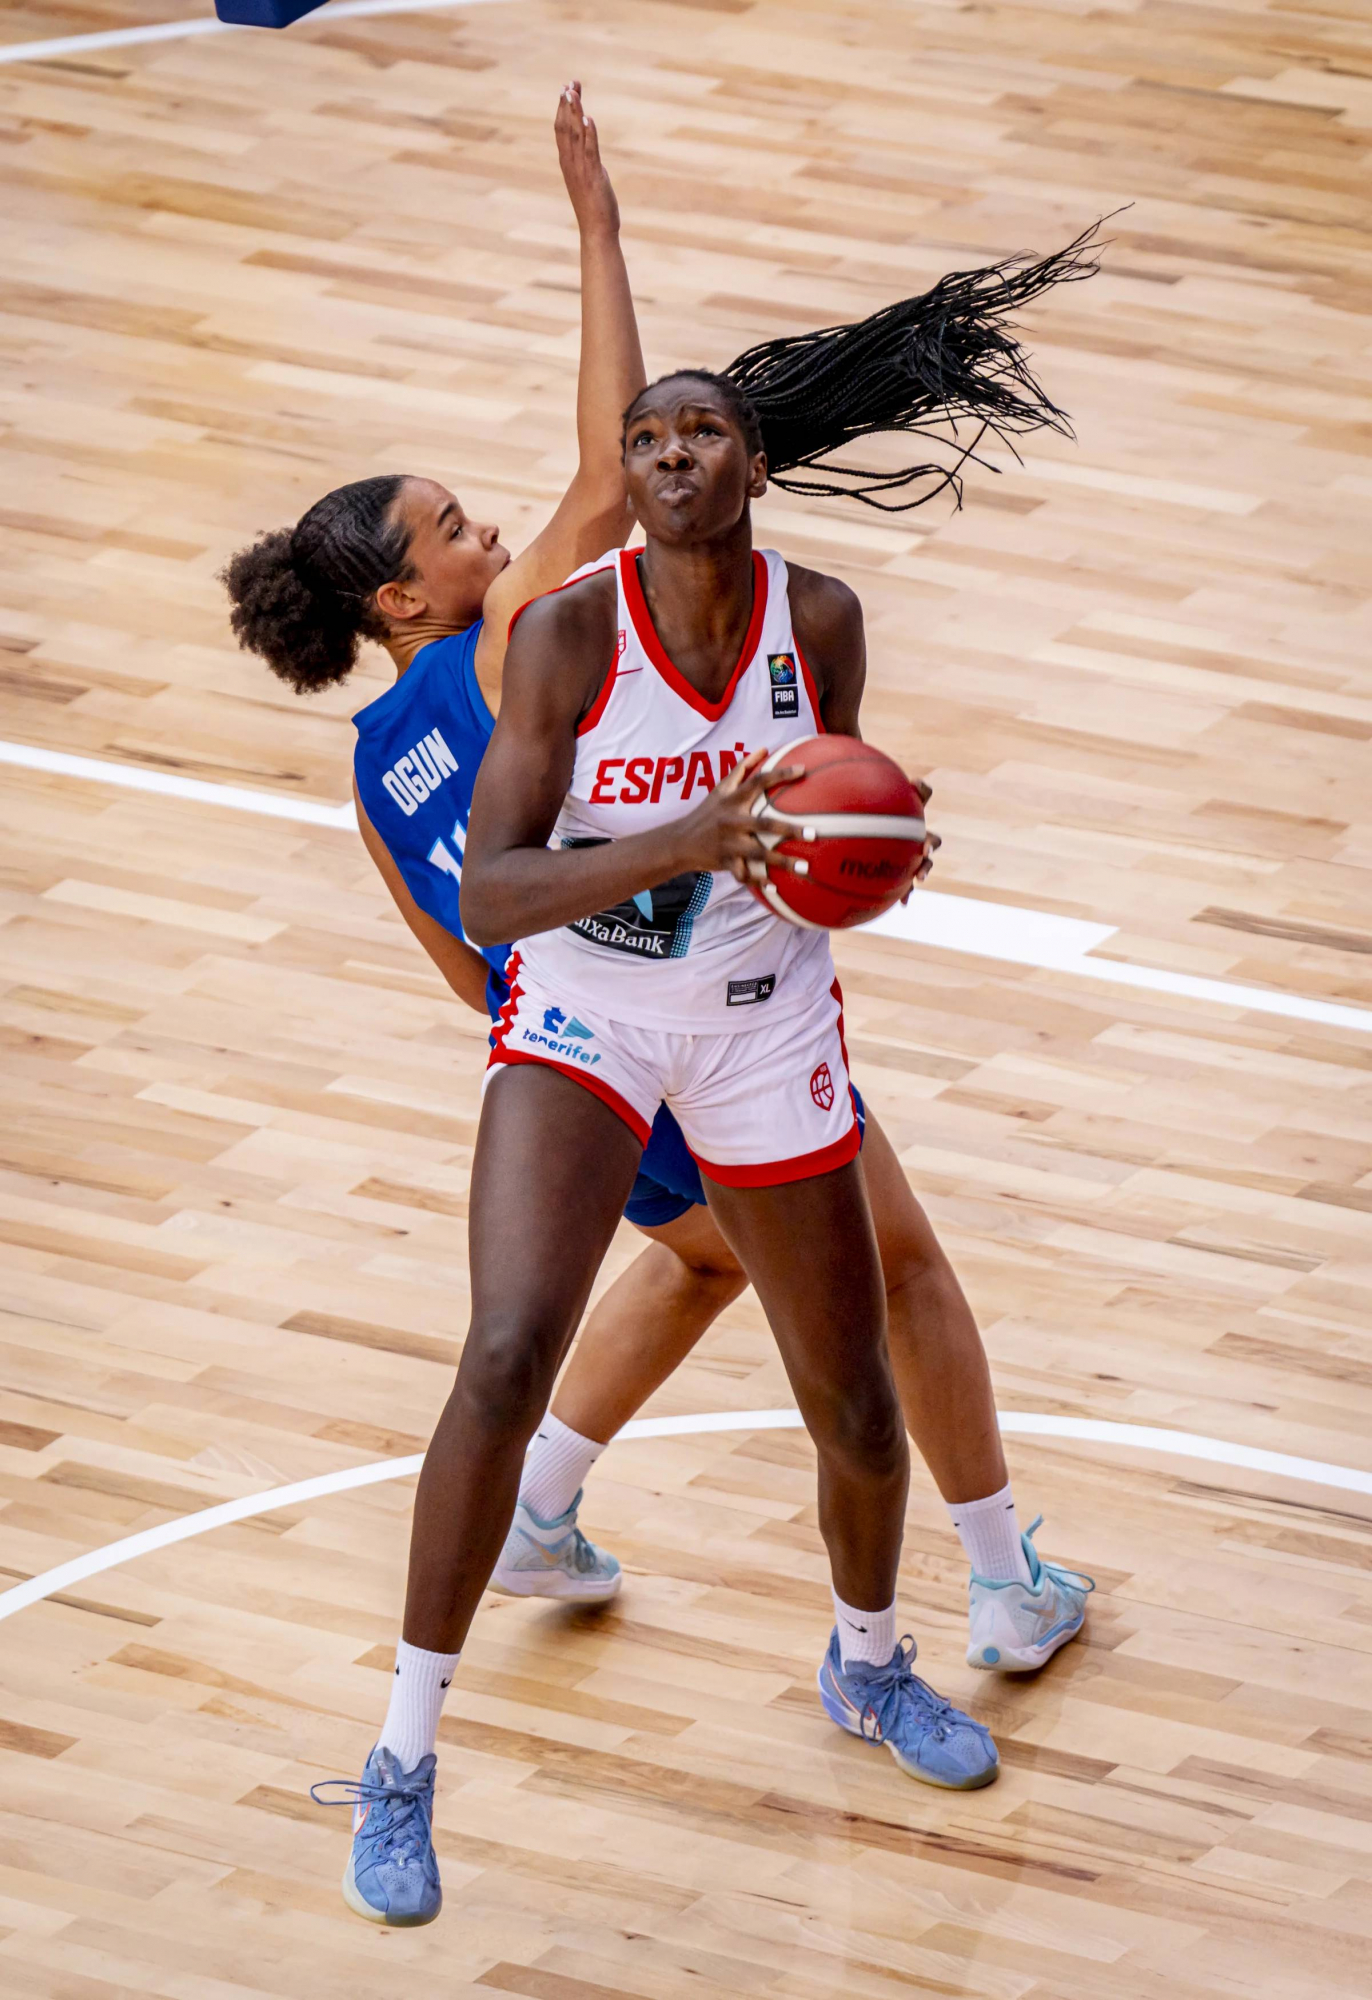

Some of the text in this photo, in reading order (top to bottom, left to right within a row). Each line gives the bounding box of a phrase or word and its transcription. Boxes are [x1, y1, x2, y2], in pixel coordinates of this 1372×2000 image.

[774, 690, 795, 702] FIBA
[382, 727, 459, 816] OGUN
[759, 983, 771, 995] XL
